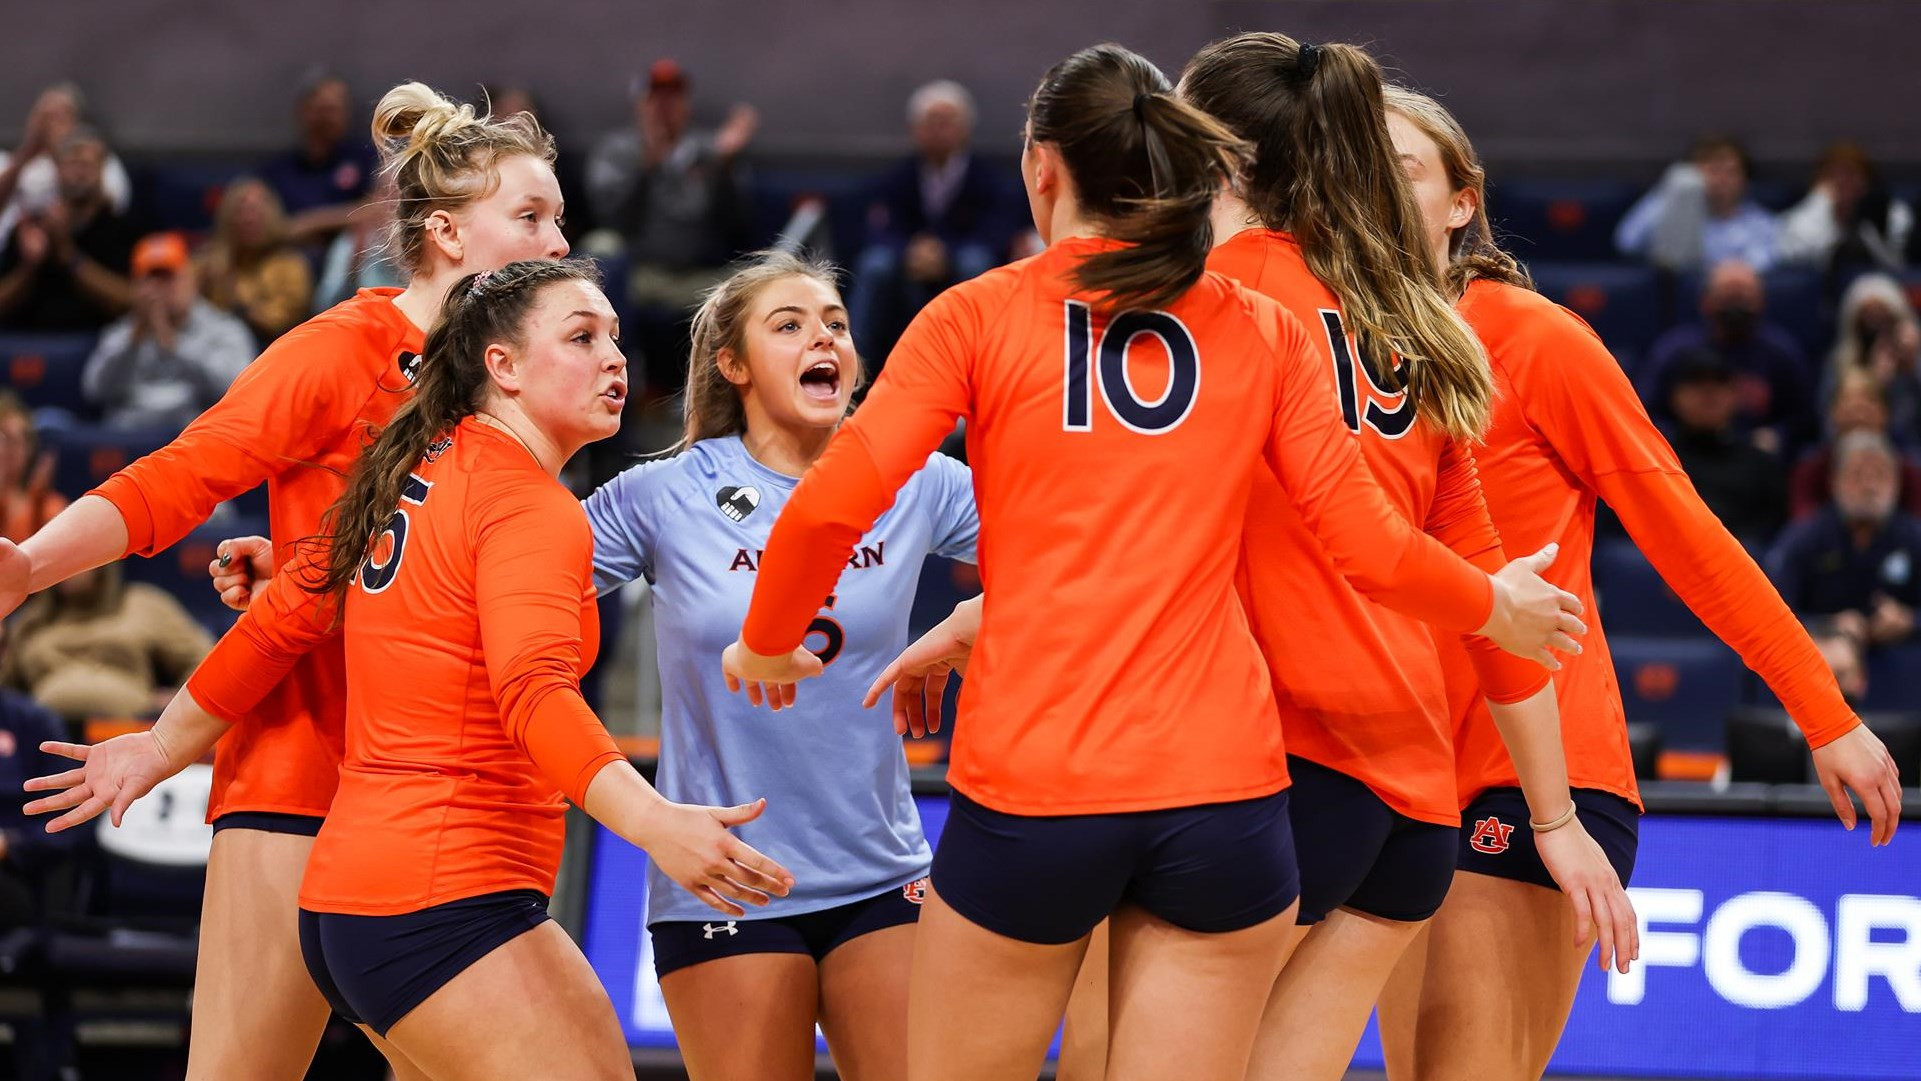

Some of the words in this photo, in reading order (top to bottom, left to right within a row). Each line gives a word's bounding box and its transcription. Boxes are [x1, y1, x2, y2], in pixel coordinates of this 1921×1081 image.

[1063, 299, 1201, 436] 10
[1317, 308, 1422, 440] 19
[729, 541, 884, 571] ARN
[1607, 887, 1921, 1013] FOR
